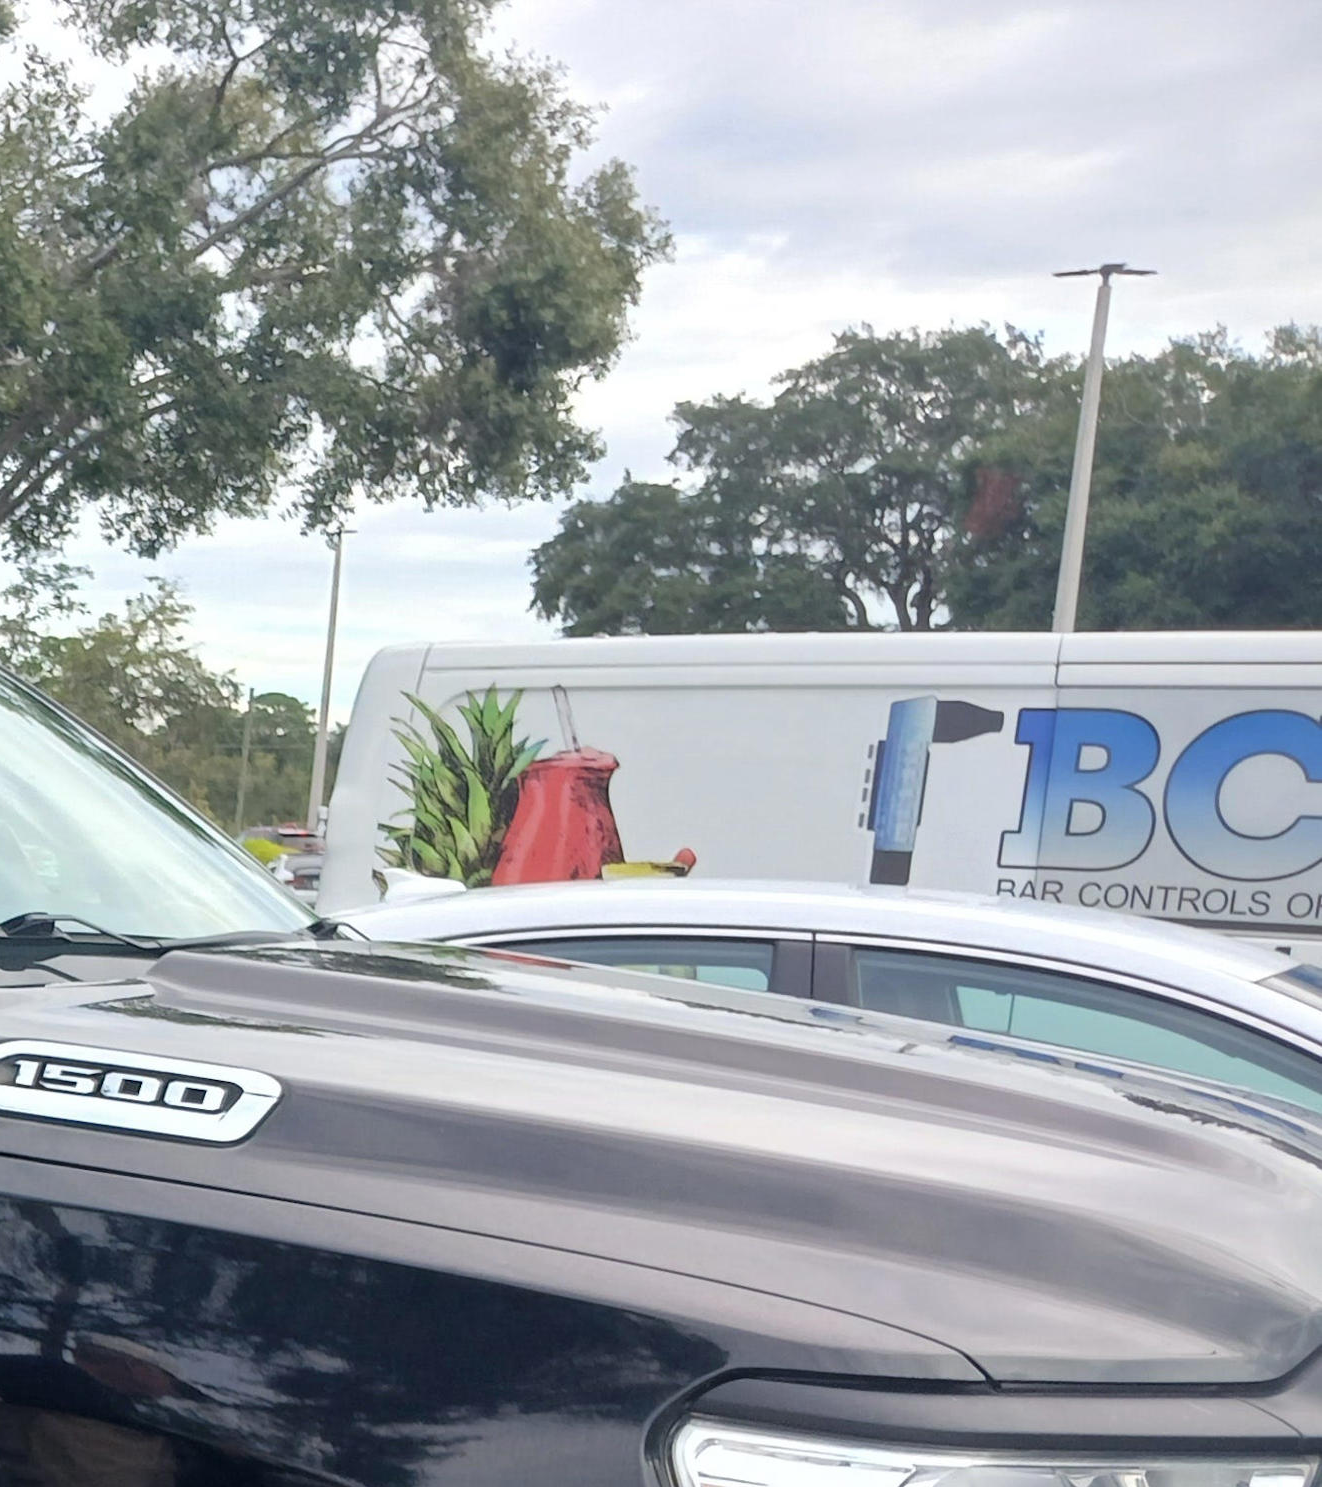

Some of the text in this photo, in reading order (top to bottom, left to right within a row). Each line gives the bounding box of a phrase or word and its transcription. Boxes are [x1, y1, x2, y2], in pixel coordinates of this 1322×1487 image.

[997, 879, 1064, 904] BAR
[1078, 882, 1271, 916] CONTROLS
[14, 1059, 229, 1112] 1500
